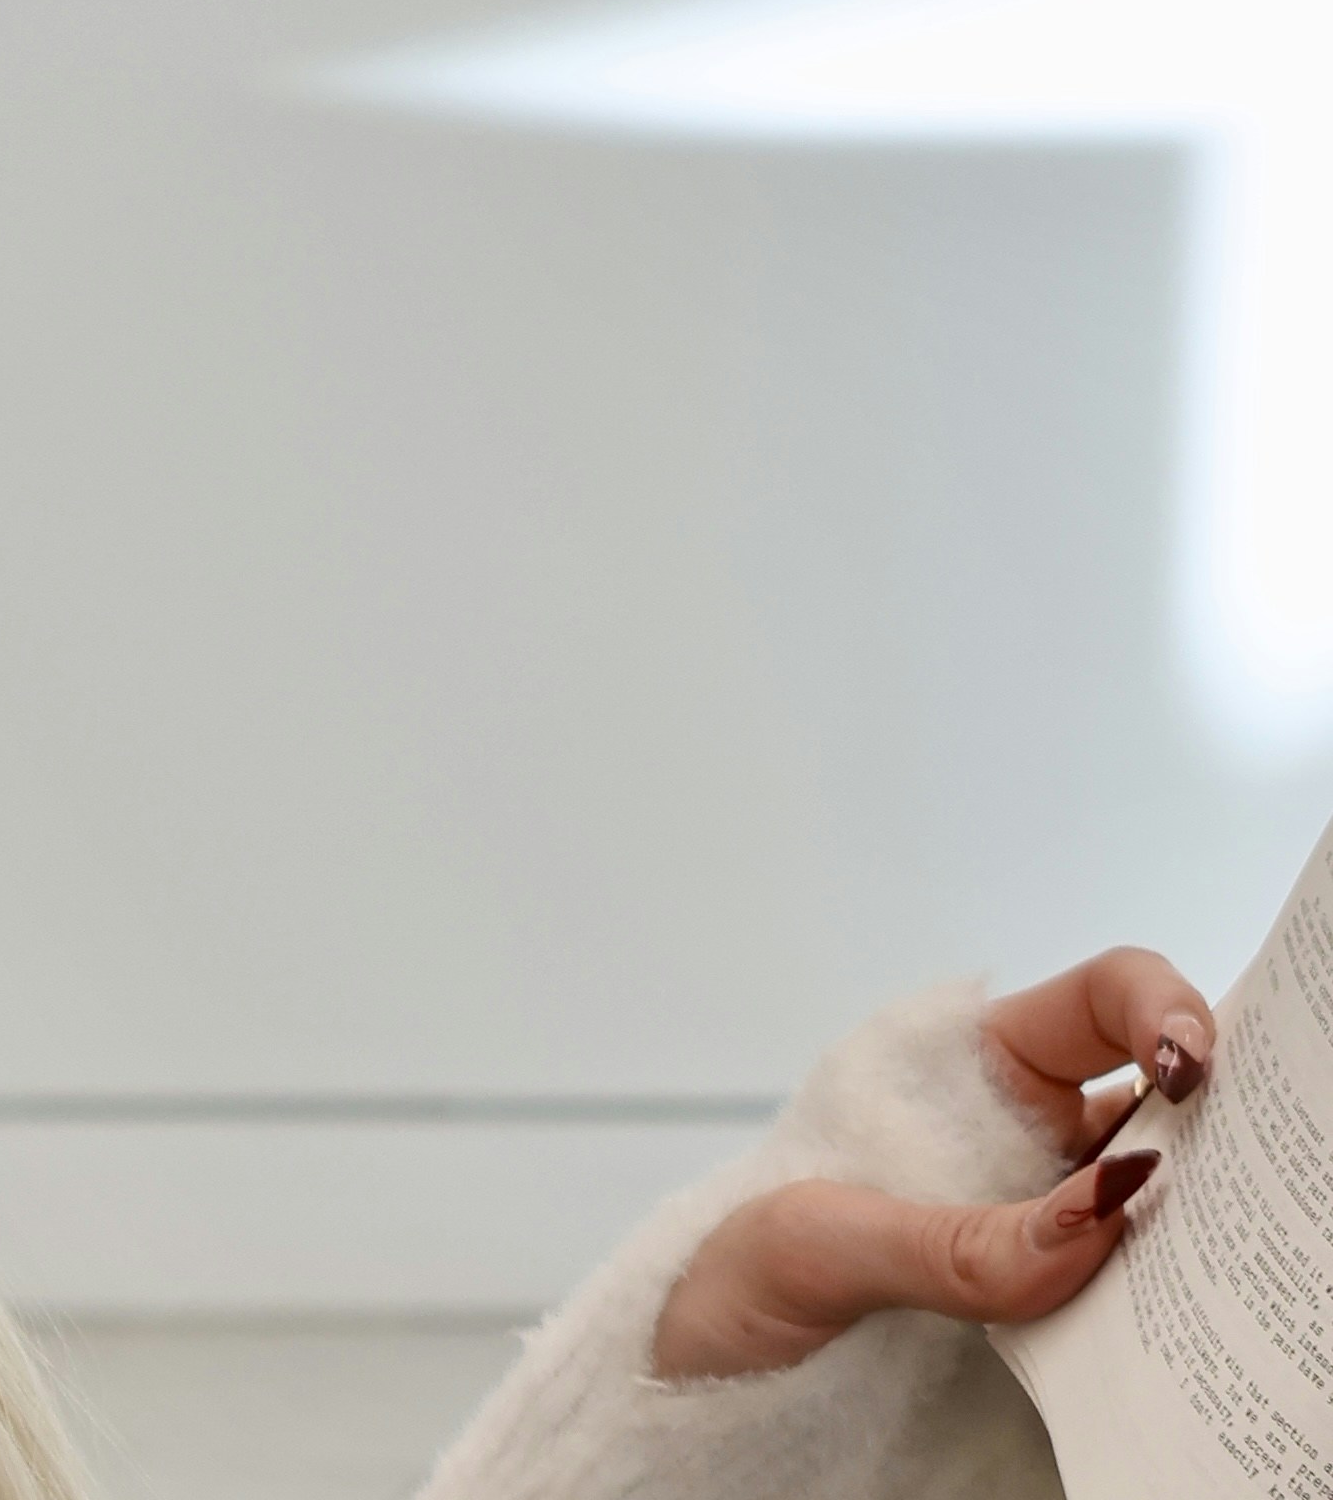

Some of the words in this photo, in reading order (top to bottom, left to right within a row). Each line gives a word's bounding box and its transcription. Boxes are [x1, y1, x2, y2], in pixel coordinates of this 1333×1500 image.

[1292, 1246, 1311, 1269] and
[1309, 1265, 1324, 1285] it
[1270, 1299, 1296, 1334] which
[1308, 1320, 1325, 1338] as
[1255, 1308, 1272, 1332] the
[1270, 1332, 1296, 1361] past
[1296, 1358, 1326, 1391] have
[1224, 1353, 1245, 1382] with
[1246, 1379, 1270, 1411] that
[1270, 1409, 1320, 1461] section
[1245, 1407, 1259, 1425] we
[1265, 1430, 1288, 1456] are
[1217, 1431, 1261, 1481] exactly
[1243, 1433, 1283, 1477] accept
